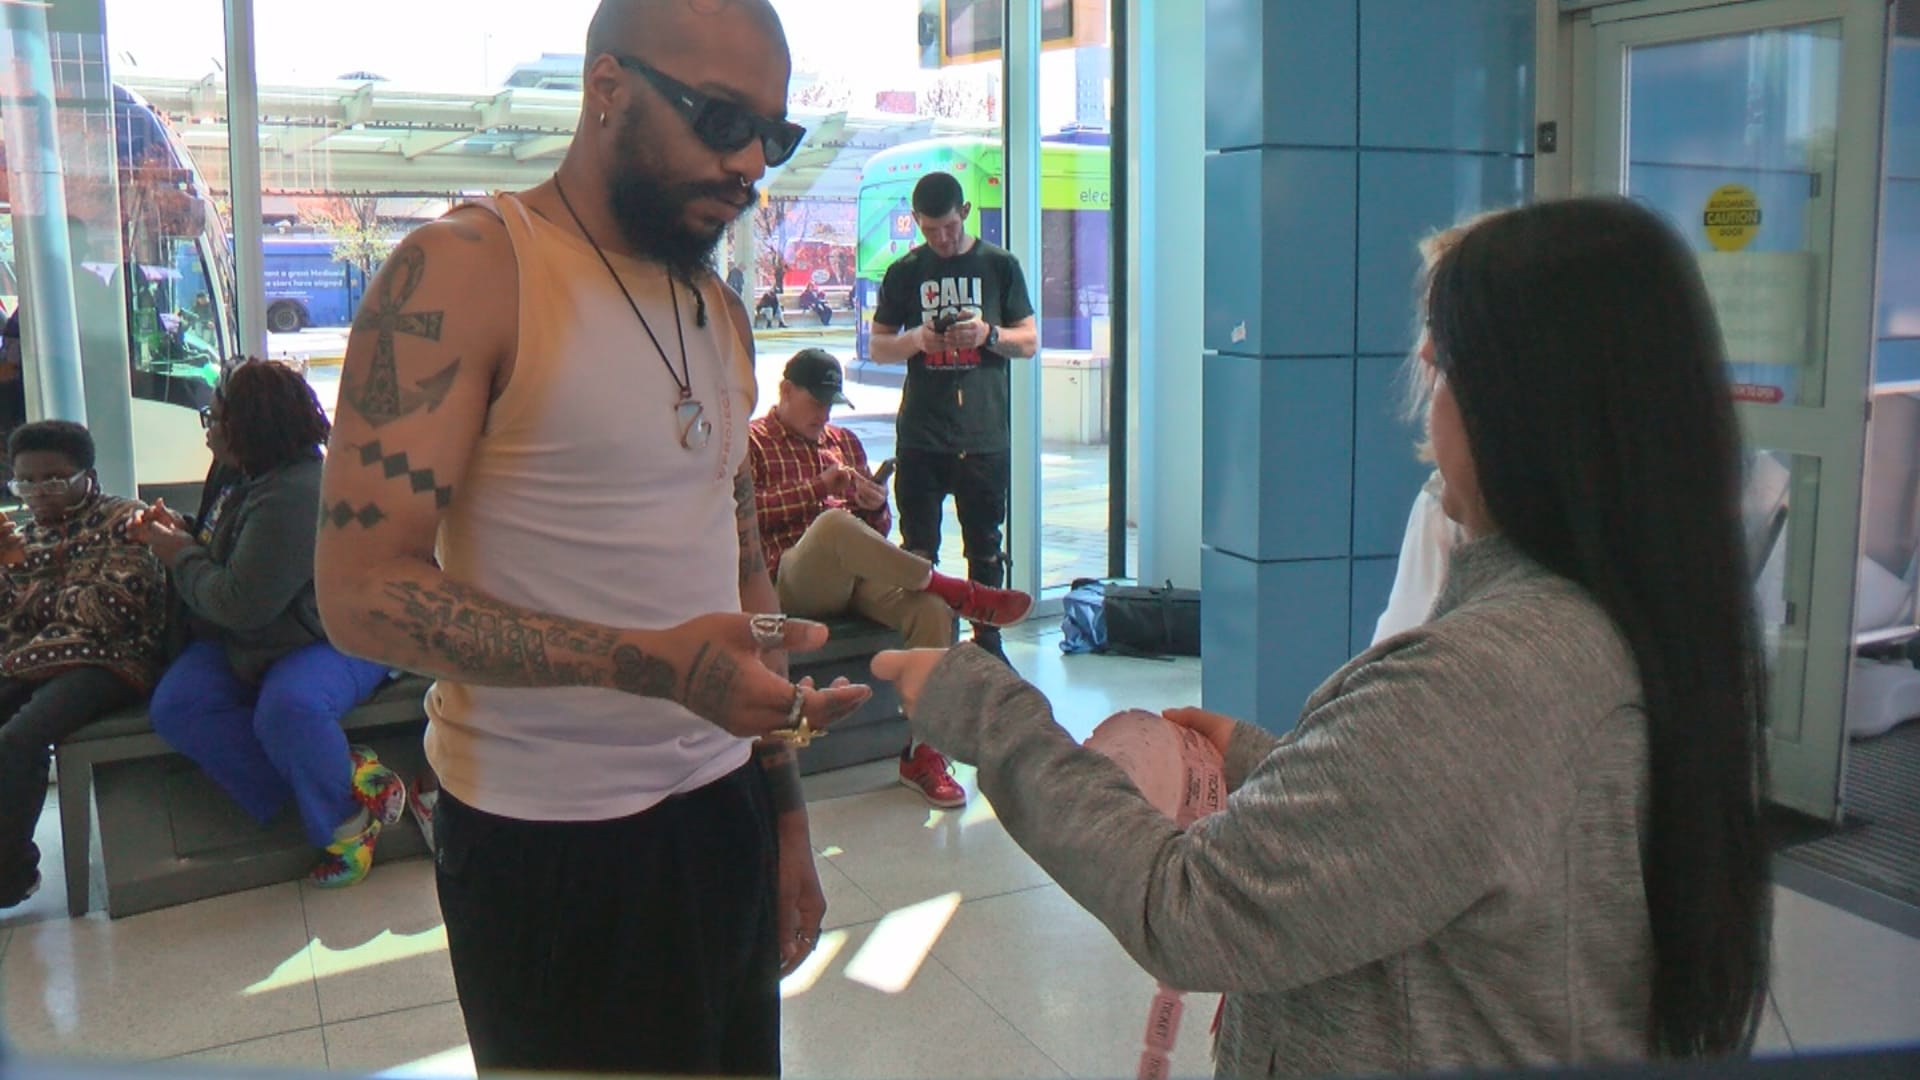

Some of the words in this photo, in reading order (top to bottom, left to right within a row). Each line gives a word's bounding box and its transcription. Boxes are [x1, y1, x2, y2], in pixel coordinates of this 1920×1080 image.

[896, 214, 912, 233] 92
[1706, 210, 1758, 225] CAUTION
[920, 276, 983, 310] CALI
[1208, 773, 1218, 809] TICKET
